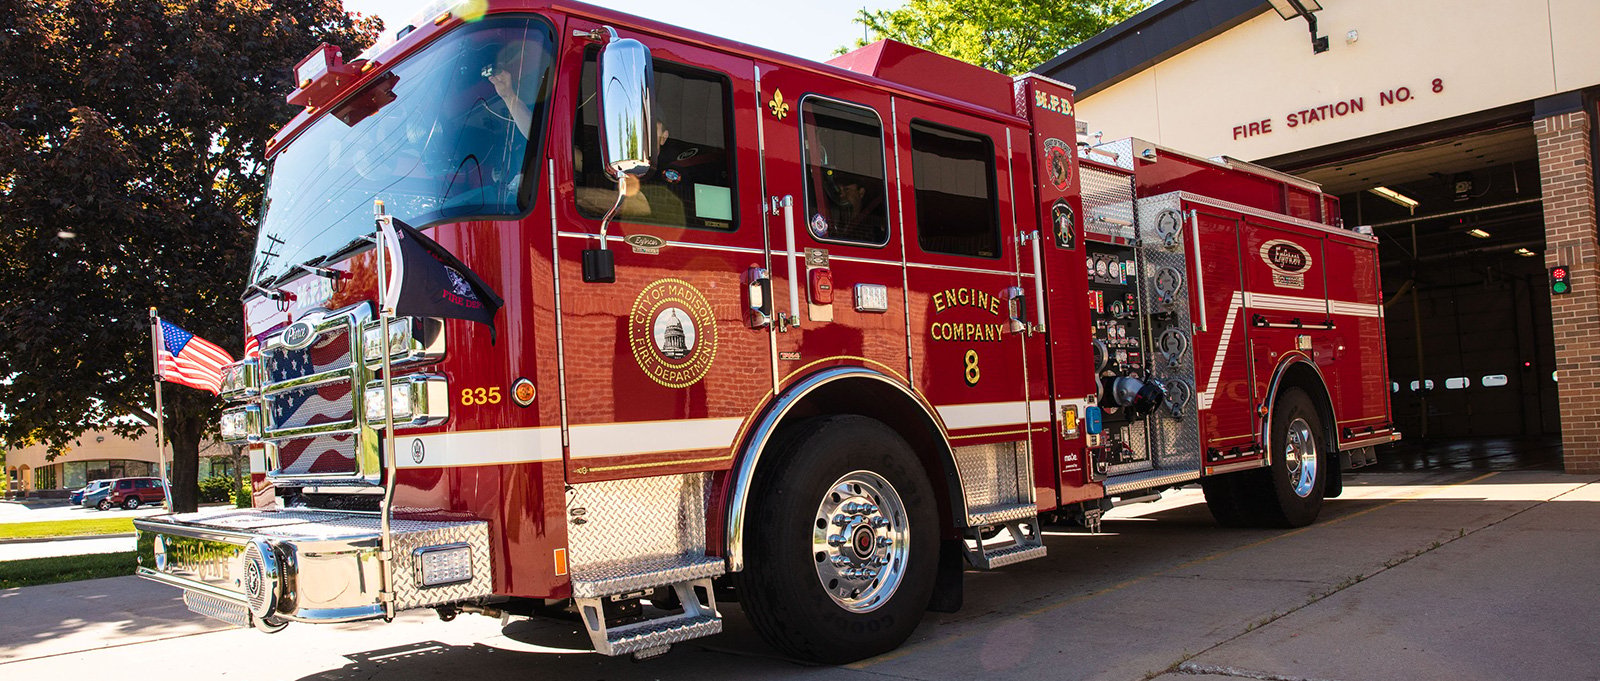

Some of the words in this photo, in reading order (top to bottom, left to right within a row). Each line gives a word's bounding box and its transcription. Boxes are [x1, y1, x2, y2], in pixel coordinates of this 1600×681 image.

[1232, 119, 1272, 140] FIRE
[1286, 97, 1364, 128] STATION
[1379, 87, 1414, 106] NO.
[1431, 78, 1444, 93] 8
[442, 288, 464, 306] FIRE
[635, 294, 653, 324] CITY
[651, 285, 666, 300] OF
[668, 284, 712, 326] MADISON
[932, 287, 1001, 316] ENGINE
[931, 322, 1004, 341] COMPANY
[636, 337, 655, 368] FIRE
[654, 339, 713, 382] DEPARTMENT
[964, 349, 980, 387] 8
[461, 386, 502, 405] 835
